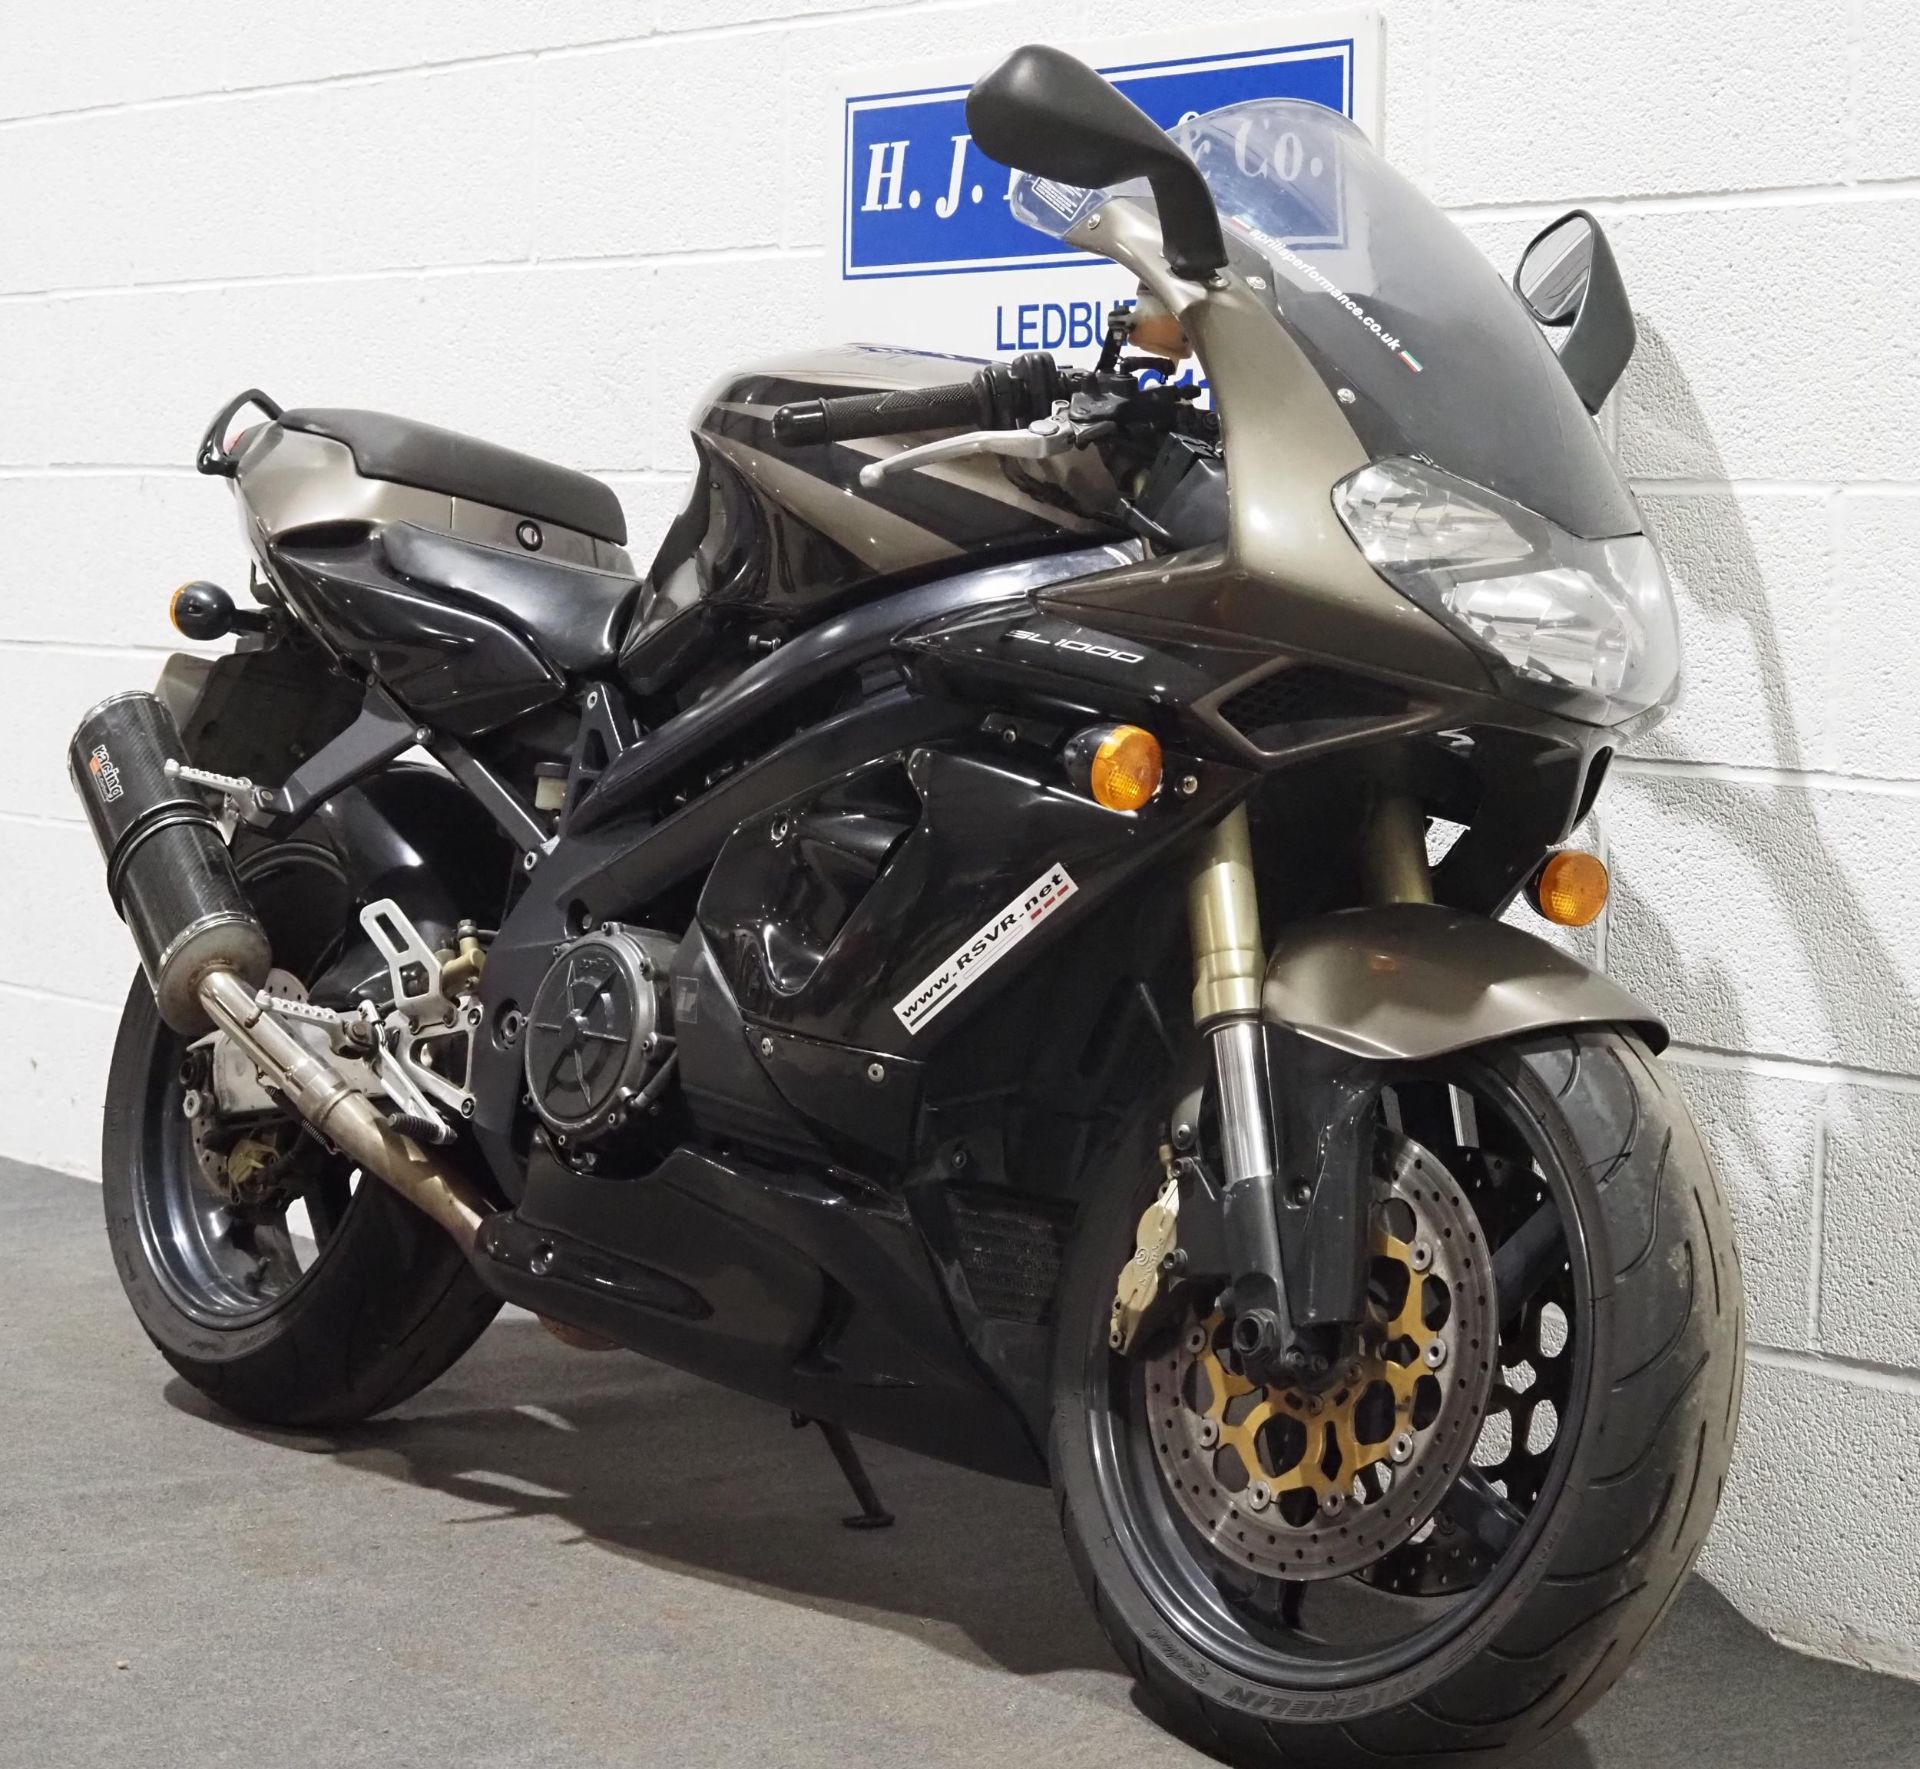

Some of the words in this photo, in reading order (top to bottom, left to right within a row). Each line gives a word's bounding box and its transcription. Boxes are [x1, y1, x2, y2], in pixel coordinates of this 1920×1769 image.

[861, 140, 921, 211] H.
[935, 134, 983, 218] J.
[1235, 116, 1324, 182] Co.
[1250, 229, 1401, 351] apriliaperformance.co.uk
[1005, 629, 1051, 644] SL
[1054, 638, 1145, 664] 1000
[92, 744, 124, 802] racing
[902, 873, 1064, 1018] www.RSVR.net
